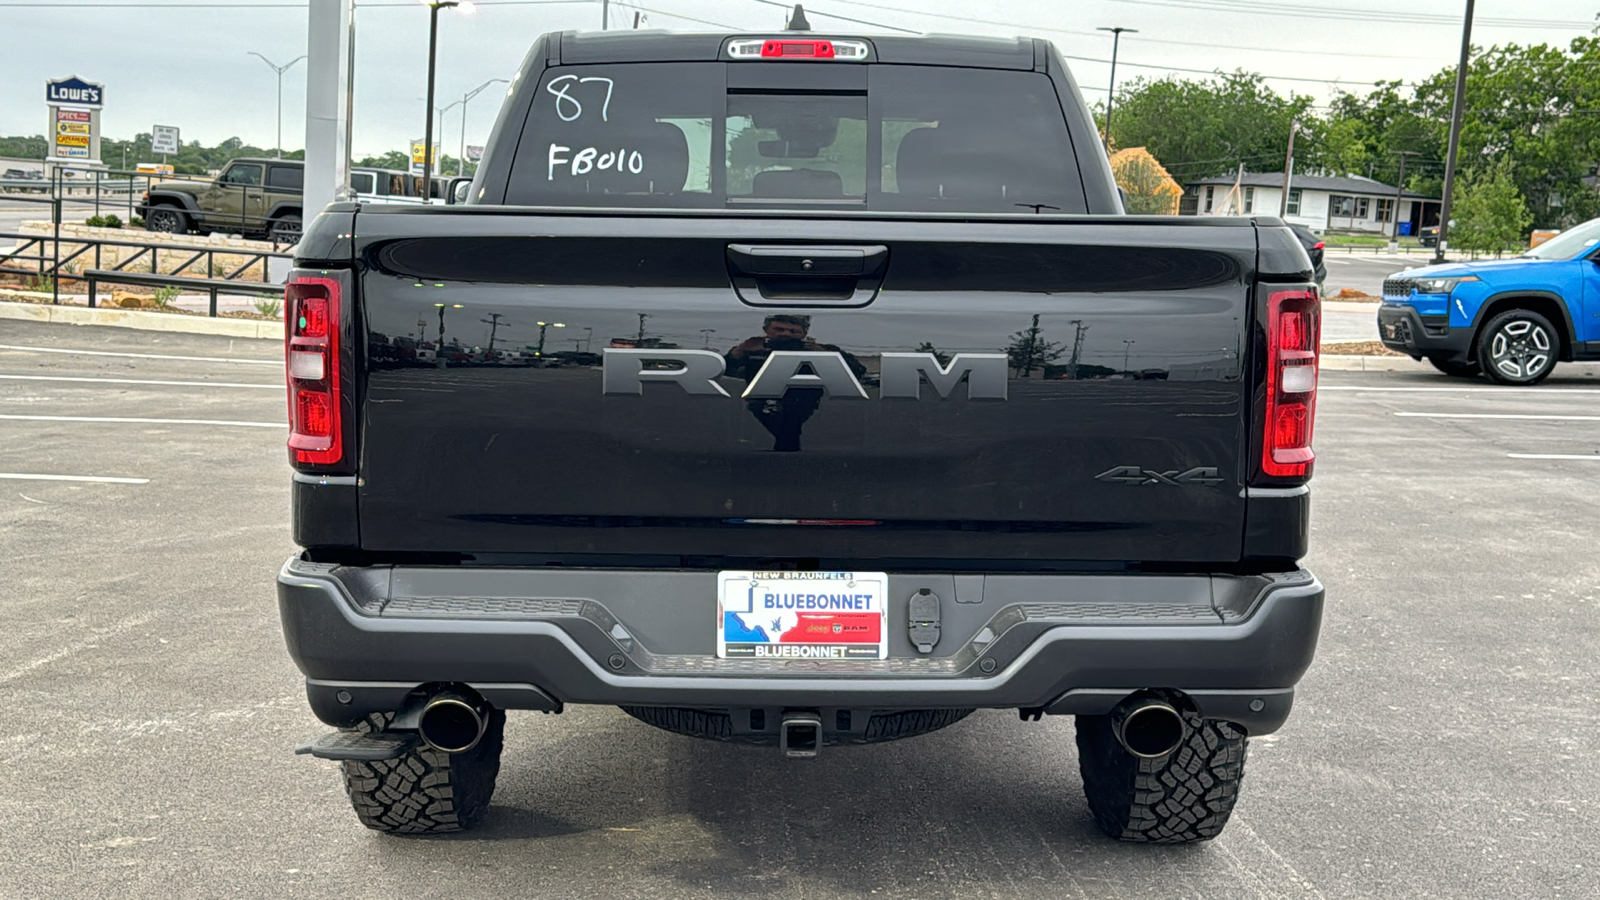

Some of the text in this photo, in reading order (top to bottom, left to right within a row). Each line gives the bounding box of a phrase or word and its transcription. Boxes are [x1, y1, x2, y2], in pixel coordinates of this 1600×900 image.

[51, 85, 99, 102] LOWE'S
[547, 74, 614, 122] 87
[602, 347, 1009, 399] RAM
[753, 571, 852, 580] NEW BRAUNFELS
[764, 593, 873, 611] BLUEBONNET
[755, 645, 848, 658] BLUEBONNET
